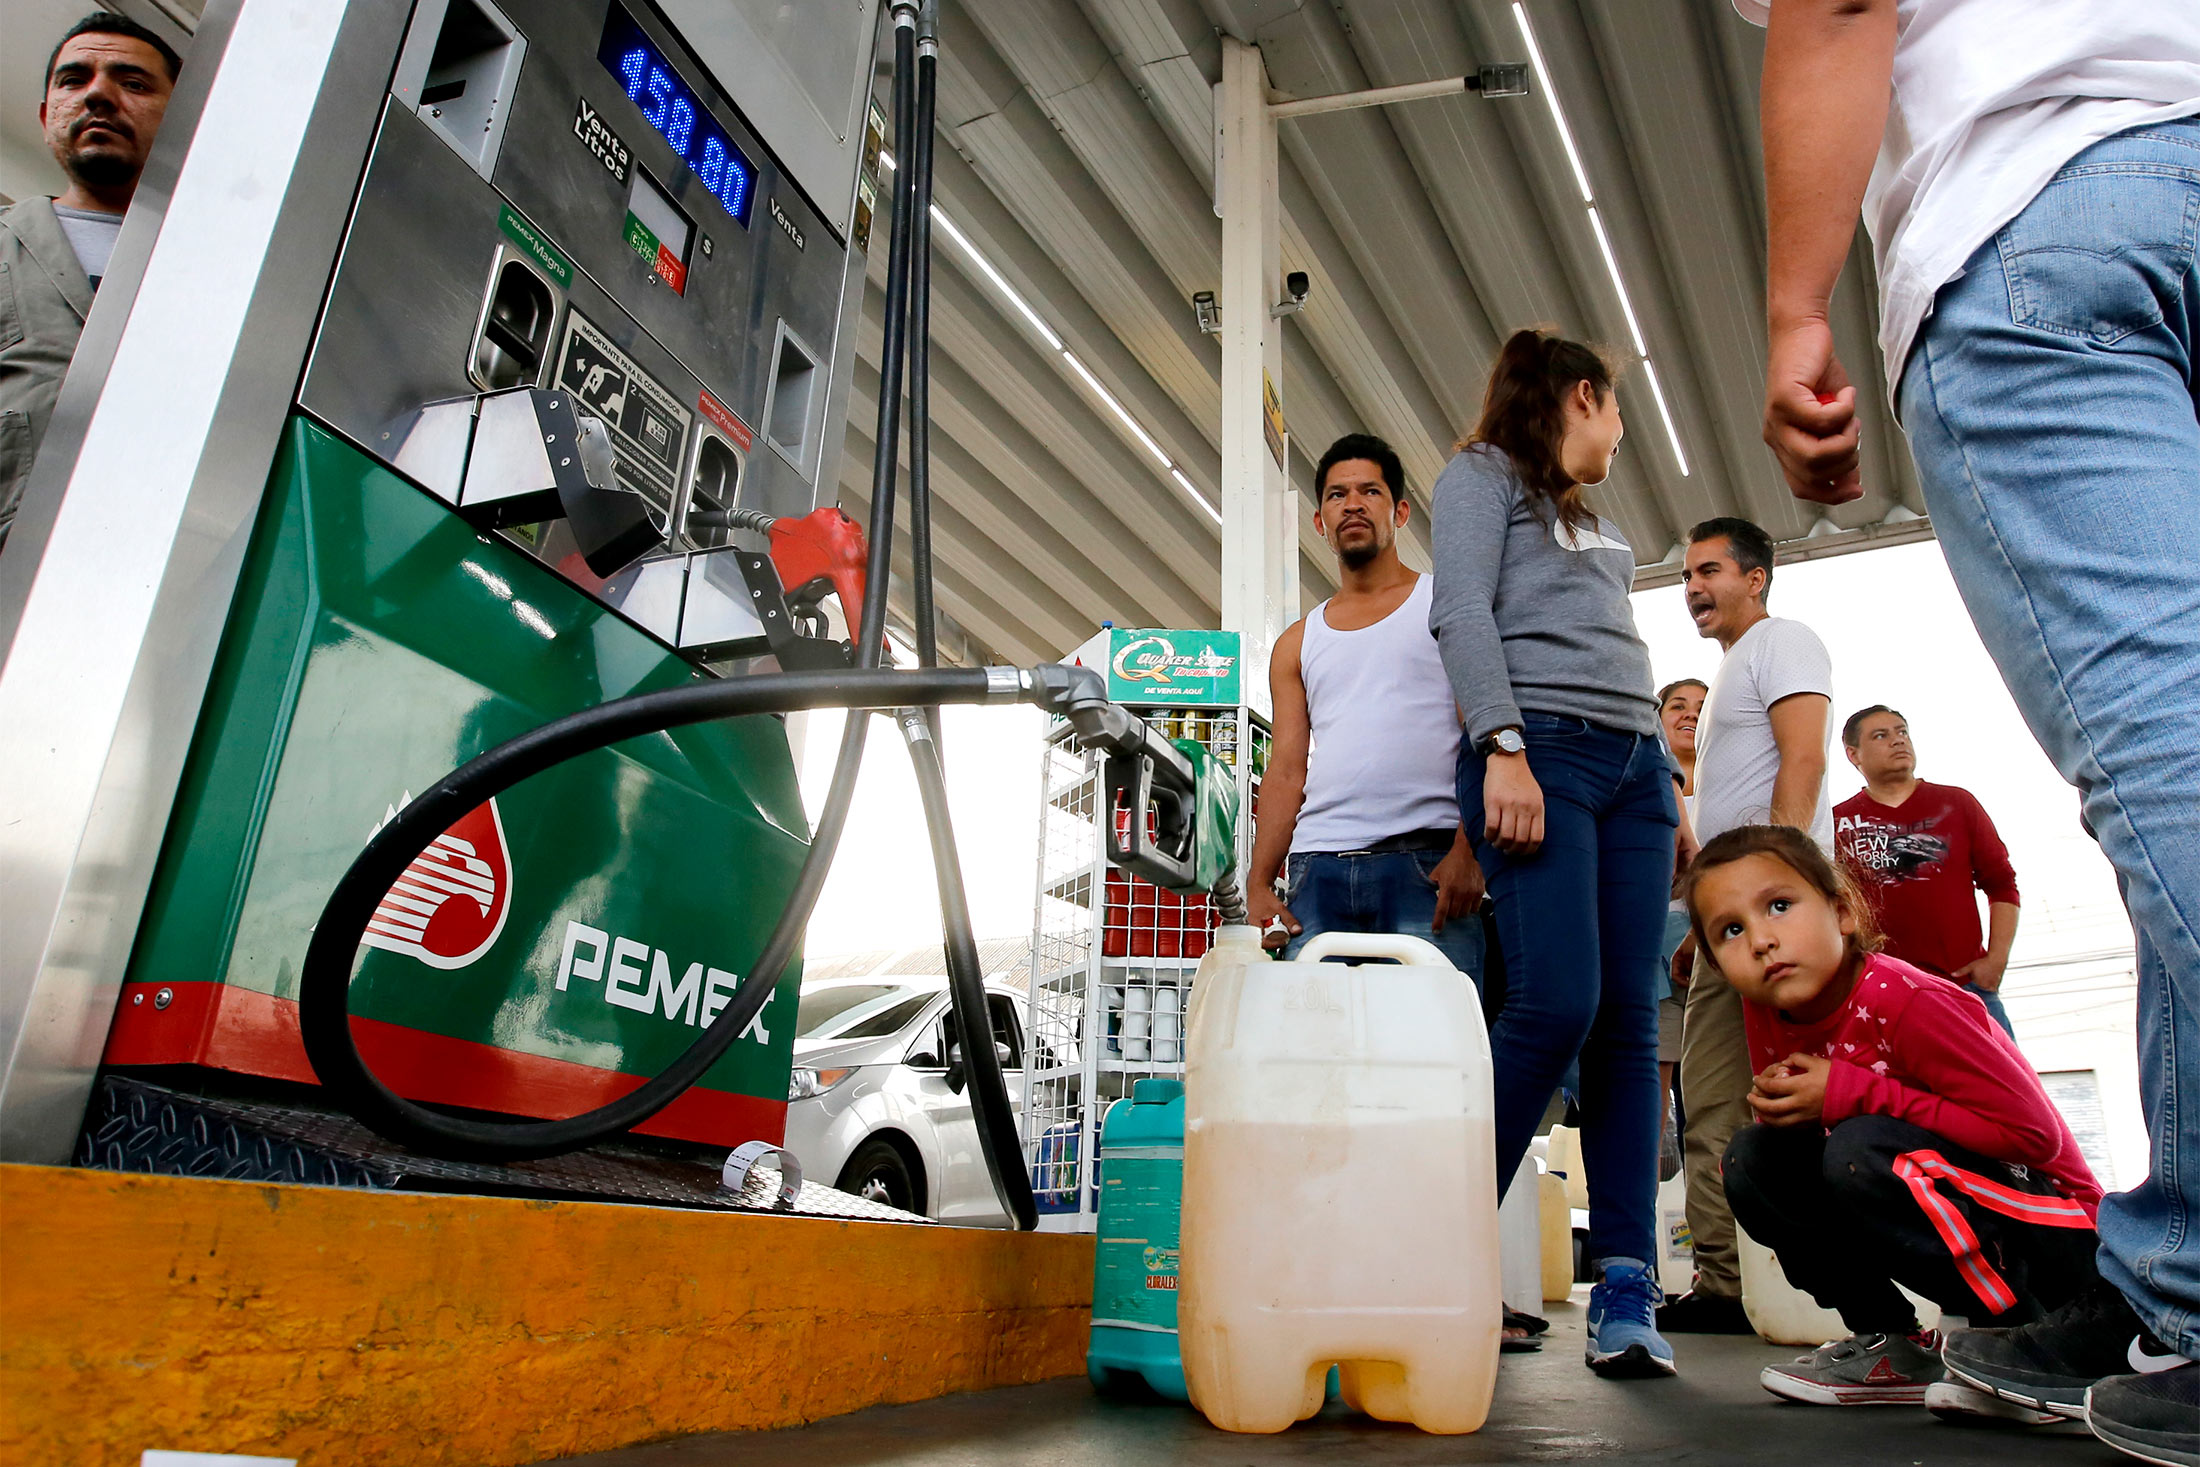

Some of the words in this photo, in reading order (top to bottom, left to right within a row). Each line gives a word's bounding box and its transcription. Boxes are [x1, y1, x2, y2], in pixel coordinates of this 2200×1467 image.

[581, 99, 628, 165] Venta
[574, 116, 624, 181] Litros
[771, 198, 803, 248] Venta
[507, 215, 535, 243] PEMEX
[533, 240, 566, 278] Magna
[575, 336, 580, 346] 1
[582, 325, 621, 363] IMPORTANTE
[620, 359, 636, 378] PARA
[637, 373, 643, 384] EL
[644, 380, 681, 417] CONSUMIDOR
[630, 384, 637, 396] 2
[719, 412, 750, 447] Premium
[1137, 653, 1194, 667] QUAKER
[1144, 687, 1158, 695] DE
[1157, 687, 1182, 695] VENTA
[1182, 687, 1204, 695] AQUÍ
[1843, 835, 1889, 859] NEW
[1857, 850, 1889, 862] YORK
[1872, 857, 1899, 870] CITY
